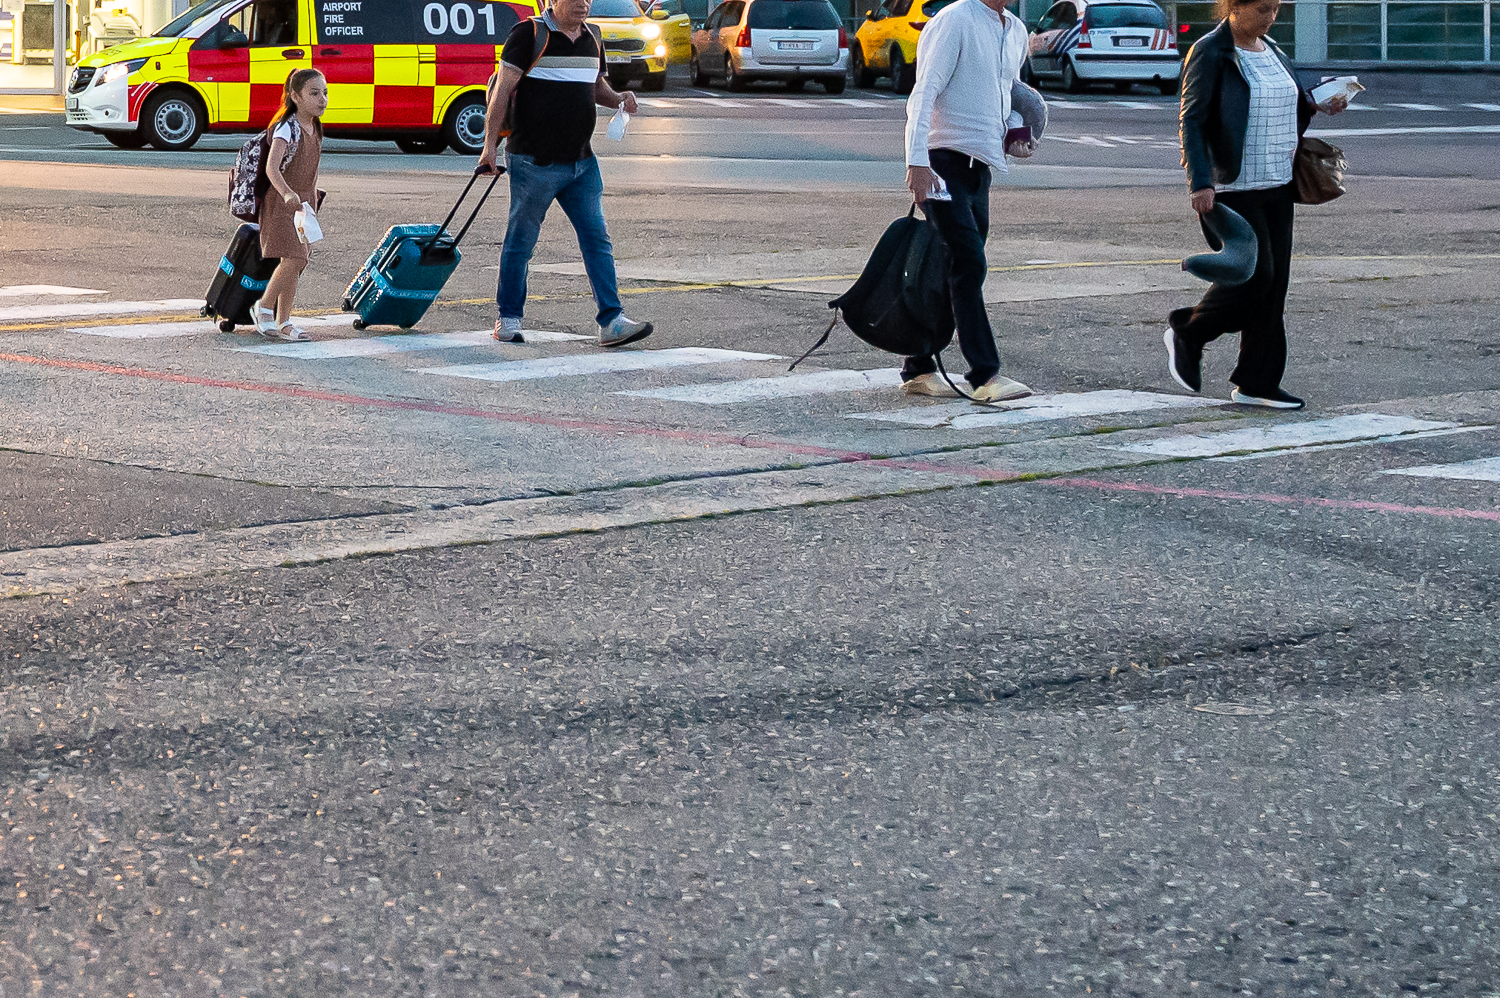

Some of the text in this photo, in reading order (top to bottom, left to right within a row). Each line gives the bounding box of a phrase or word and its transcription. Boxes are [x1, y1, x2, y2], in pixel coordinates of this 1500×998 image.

[323, 1, 362, 11] AIRPORT
[324, 14, 344, 23] FIRE
[423, 2, 496, 35] 001
[325, 26, 363, 36] OFFICER
